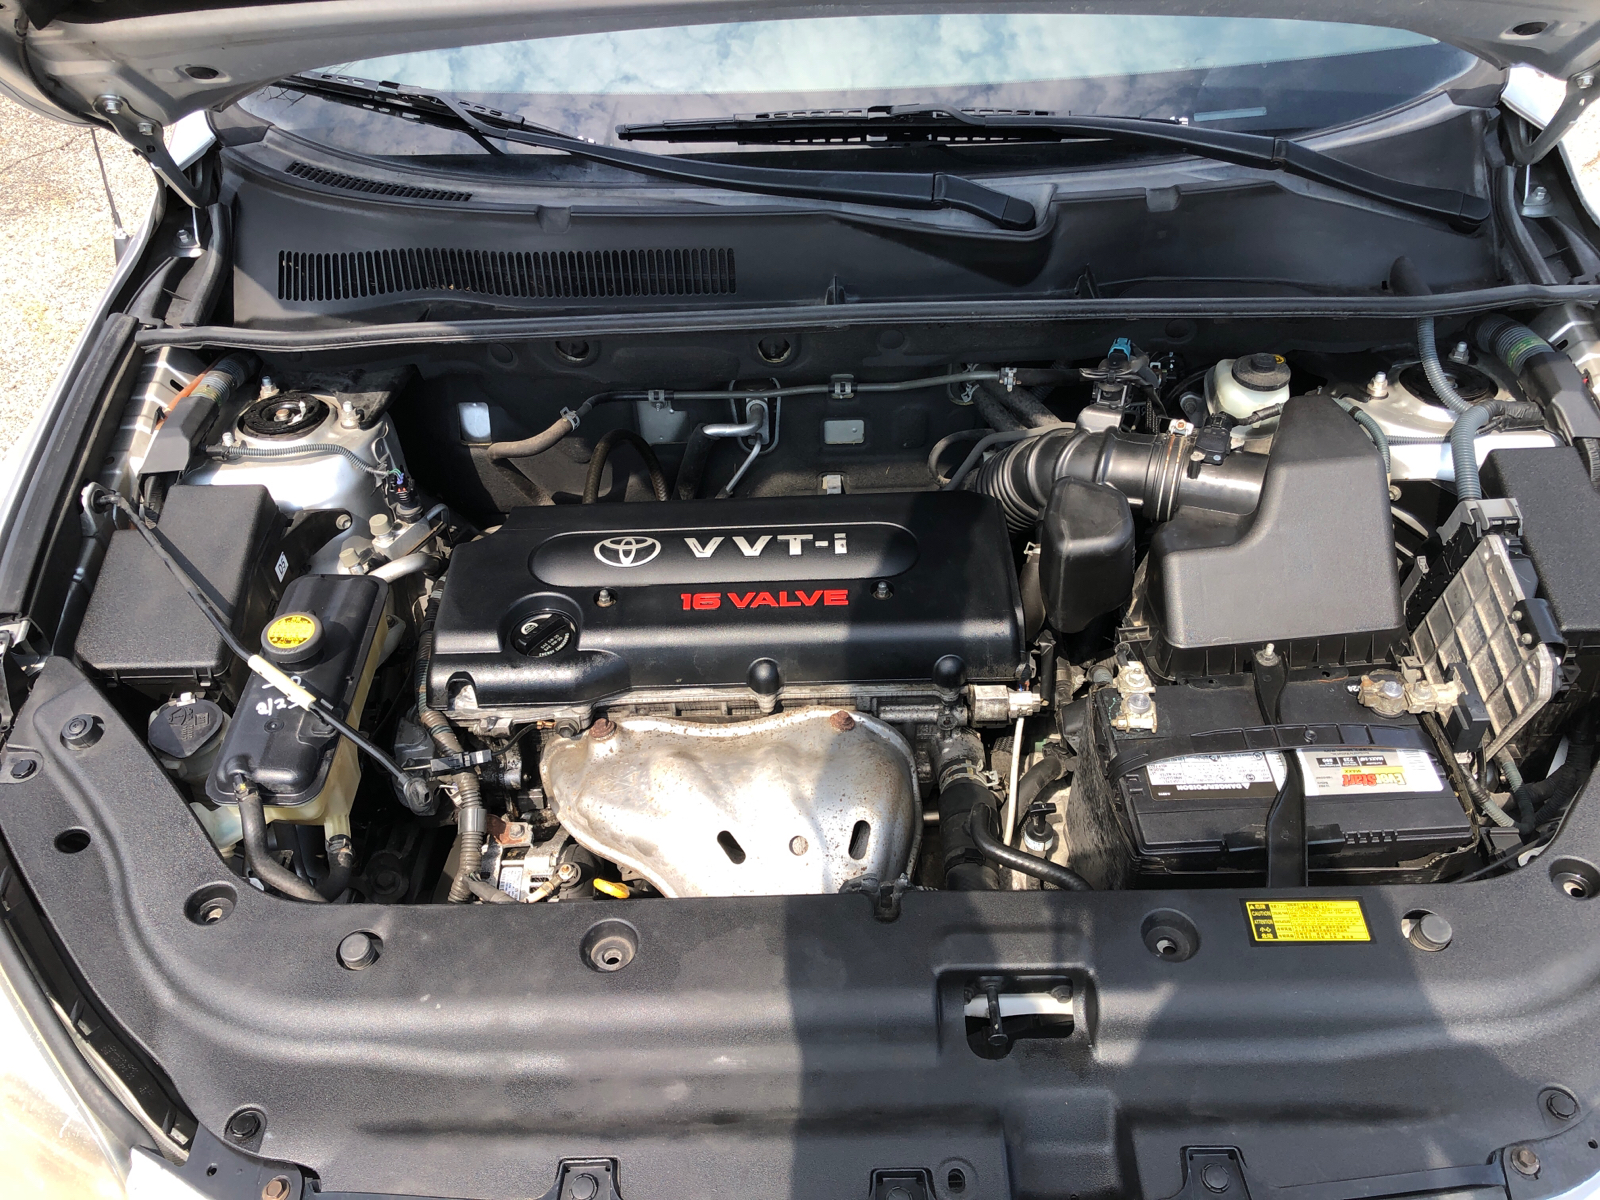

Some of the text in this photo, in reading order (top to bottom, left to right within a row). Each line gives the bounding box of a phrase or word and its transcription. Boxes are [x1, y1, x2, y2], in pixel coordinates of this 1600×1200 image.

[684, 533, 848, 558] VVT-i
[681, 589, 849, 610] 16 VALVE
